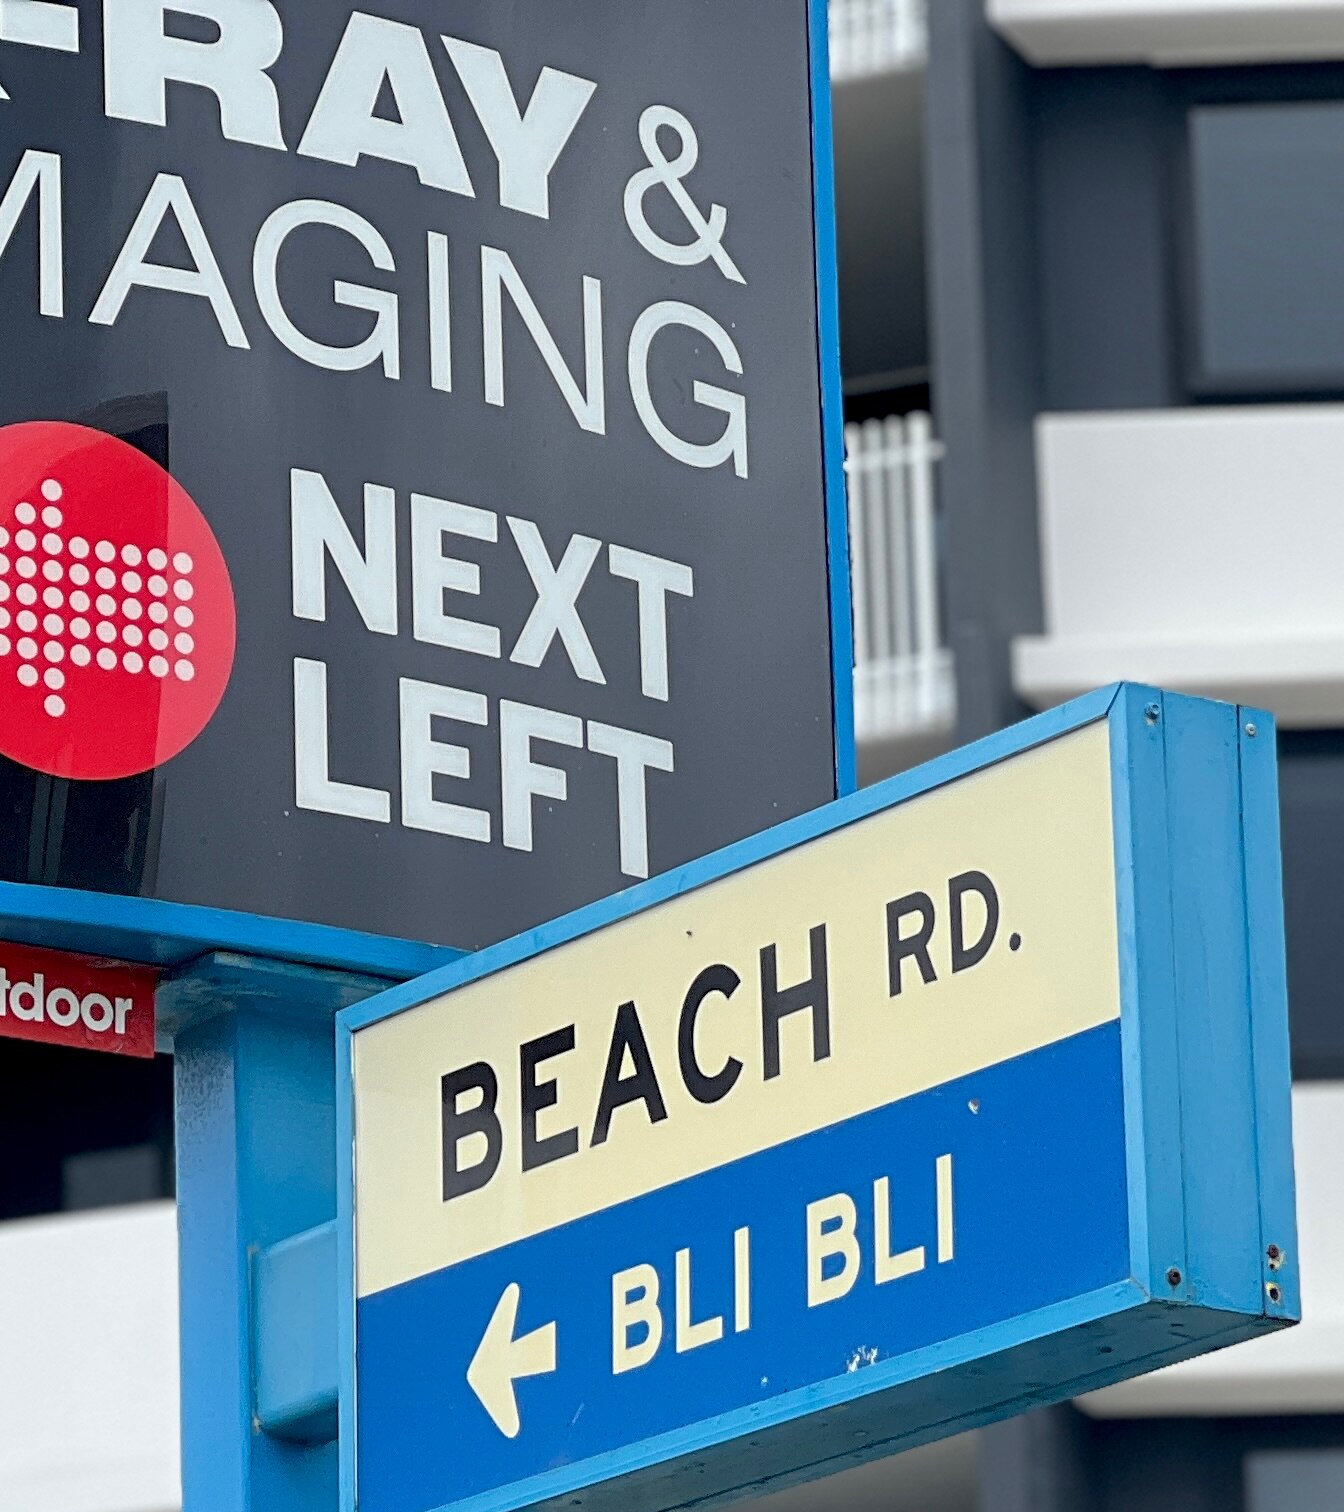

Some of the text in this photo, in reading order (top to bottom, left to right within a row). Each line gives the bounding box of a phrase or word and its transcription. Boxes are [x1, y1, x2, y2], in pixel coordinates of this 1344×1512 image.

[622, 105, 747, 285] &
[291, 469, 693, 701] NEXT
[293, 658, 674, 879] LEFT
[442, 870, 1021, 1201] BEACH RD.
[613, 1153, 954, 1373] BLI BLI
